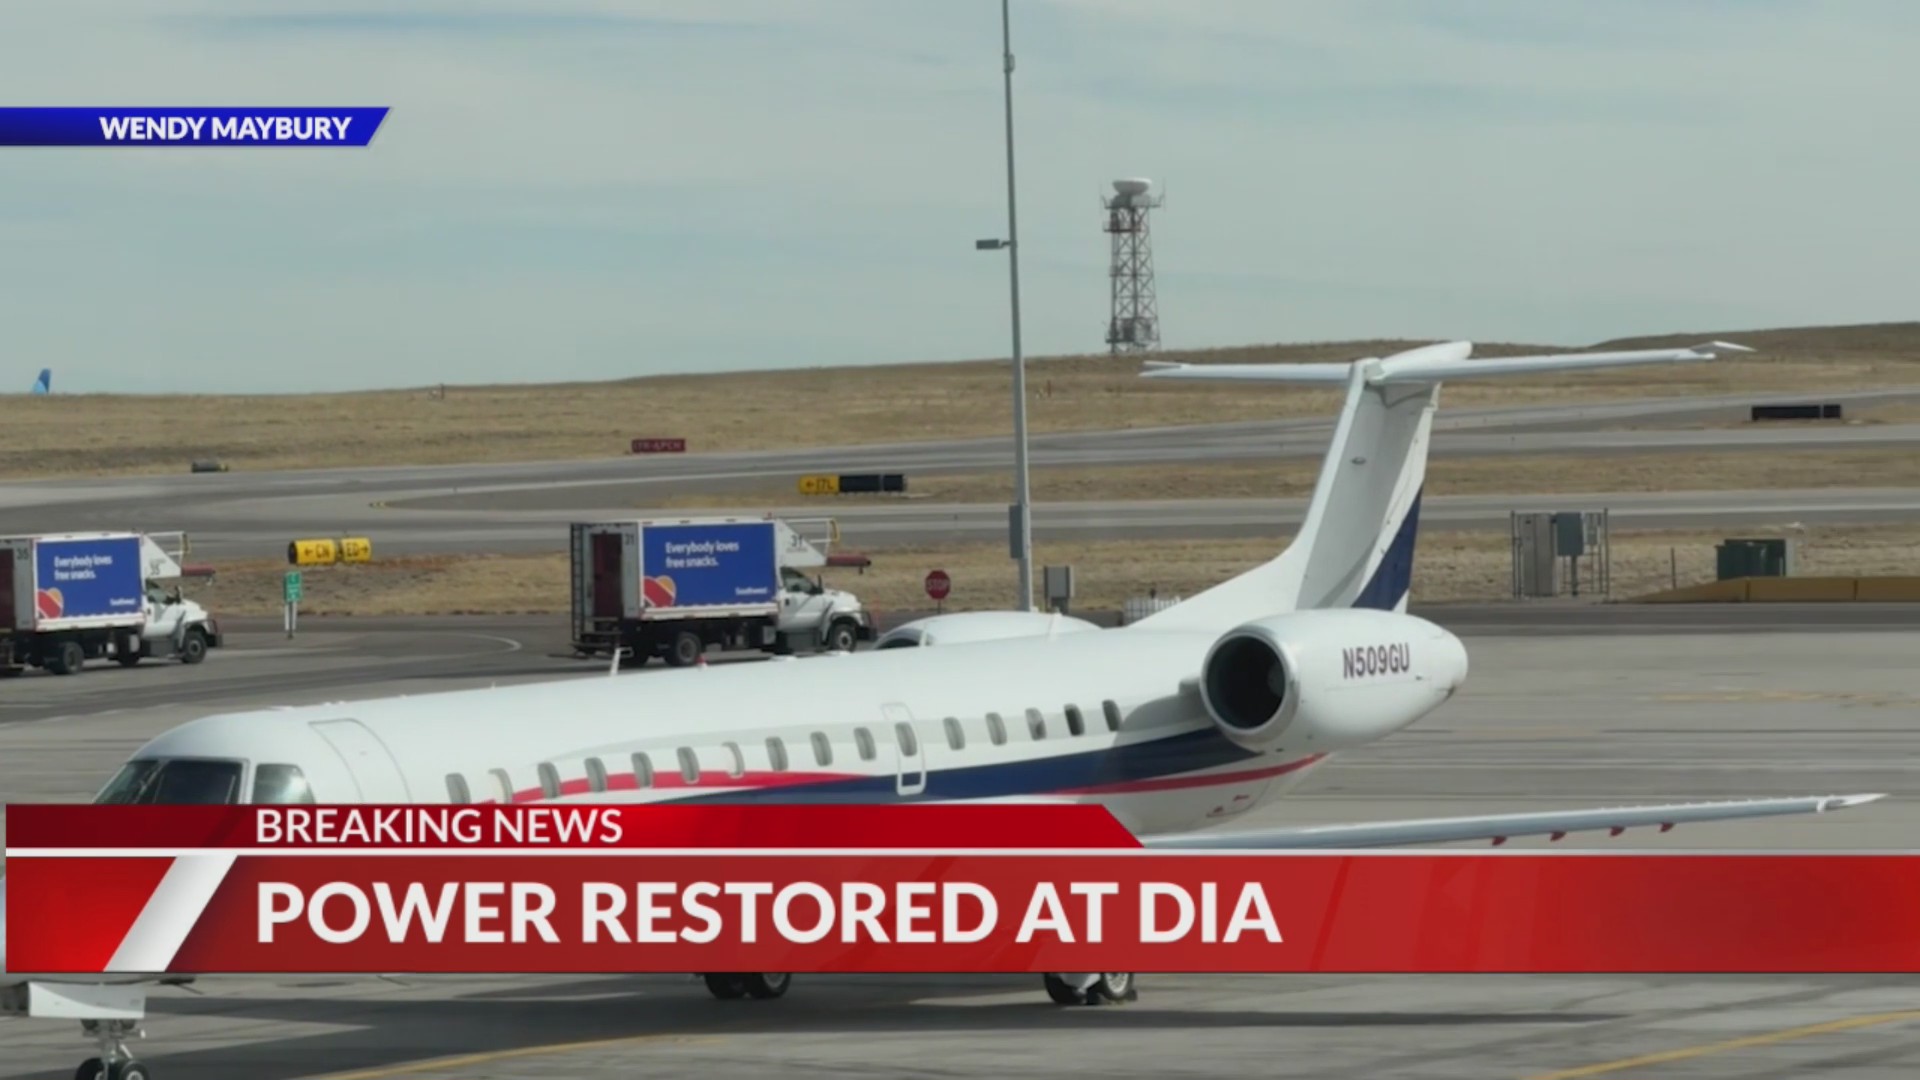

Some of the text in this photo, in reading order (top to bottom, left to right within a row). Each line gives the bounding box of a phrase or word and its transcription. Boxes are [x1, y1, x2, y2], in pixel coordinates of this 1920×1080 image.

[665, 540, 740, 556] Everybody loves
[54, 554, 113, 568] Everybody loves
[666, 555, 719, 568] free snacks.
[54, 567, 96, 581] free snacks.
[735, 586, 768, 596] Southwest
[926, 578, 949, 591] STOP
[1342, 641, 1411, 680] N509GU
